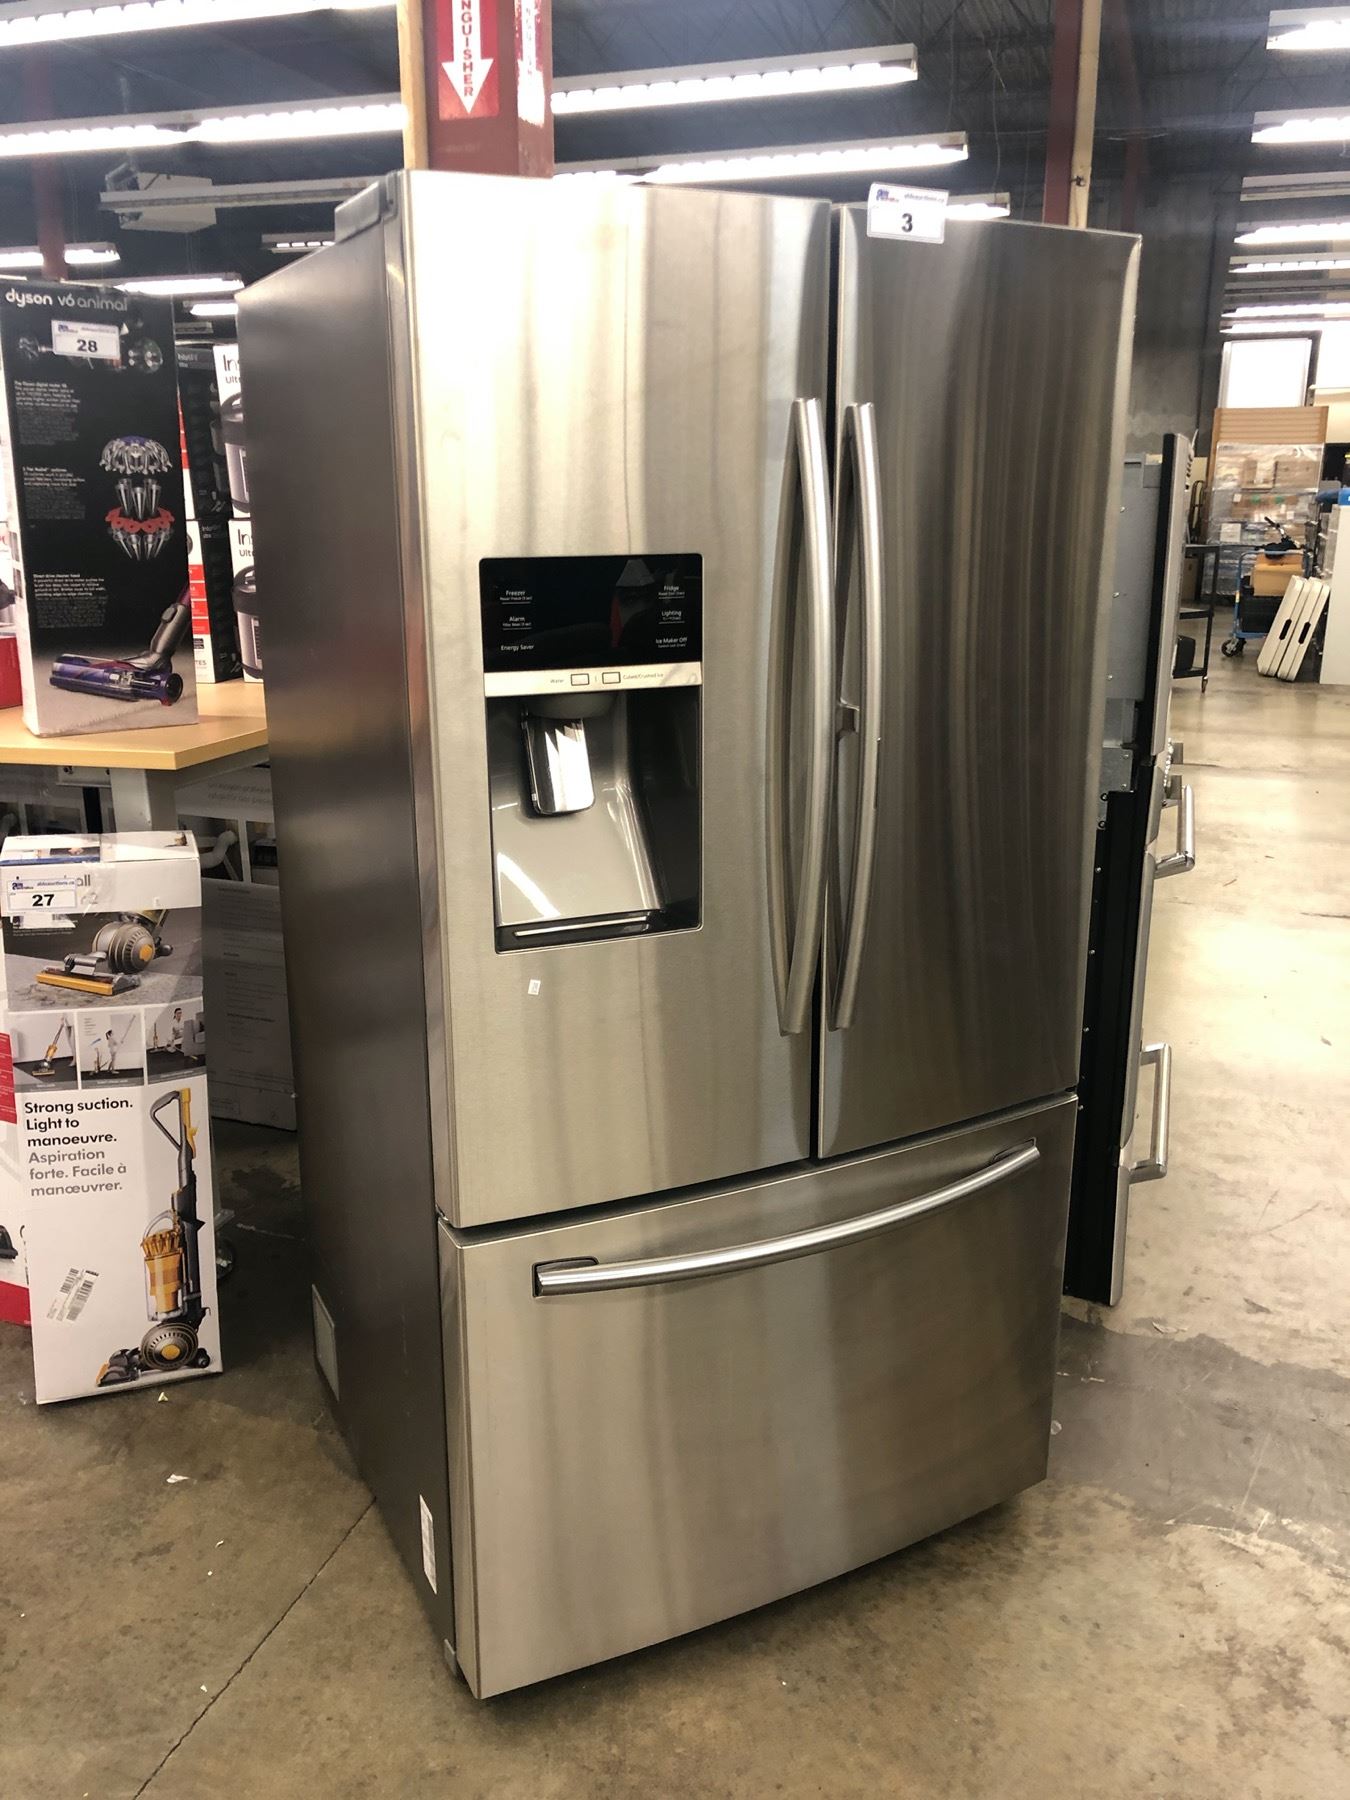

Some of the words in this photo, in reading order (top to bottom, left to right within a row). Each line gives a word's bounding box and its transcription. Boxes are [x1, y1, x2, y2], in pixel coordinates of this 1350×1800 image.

[901, 213, 913, 232] 3
[5, 288, 53, 308] dyson
[77, 294, 128, 312] animal
[77, 339, 98, 353] 28
[223, 354, 240, 372] In
[237, 528, 253, 546] In
[239, 549, 255, 558] Ult
[500, 644, 519, 652] Energy
[32, 894, 55, 907] 27
[24, 1102, 74, 1115] Strong
[77, 1097, 133, 1111] suction.
[26, 1117, 62, 1133] Light
[65, 1118, 80, 1128] to
[27, 1133, 117, 1147] manoeuvre.
[28, 1148, 105, 1165] Aspiration
[29, 1167, 69, 1180] forte.
[72, 1163, 114, 1177] Facile
[117, 1162, 127, 1174] à
